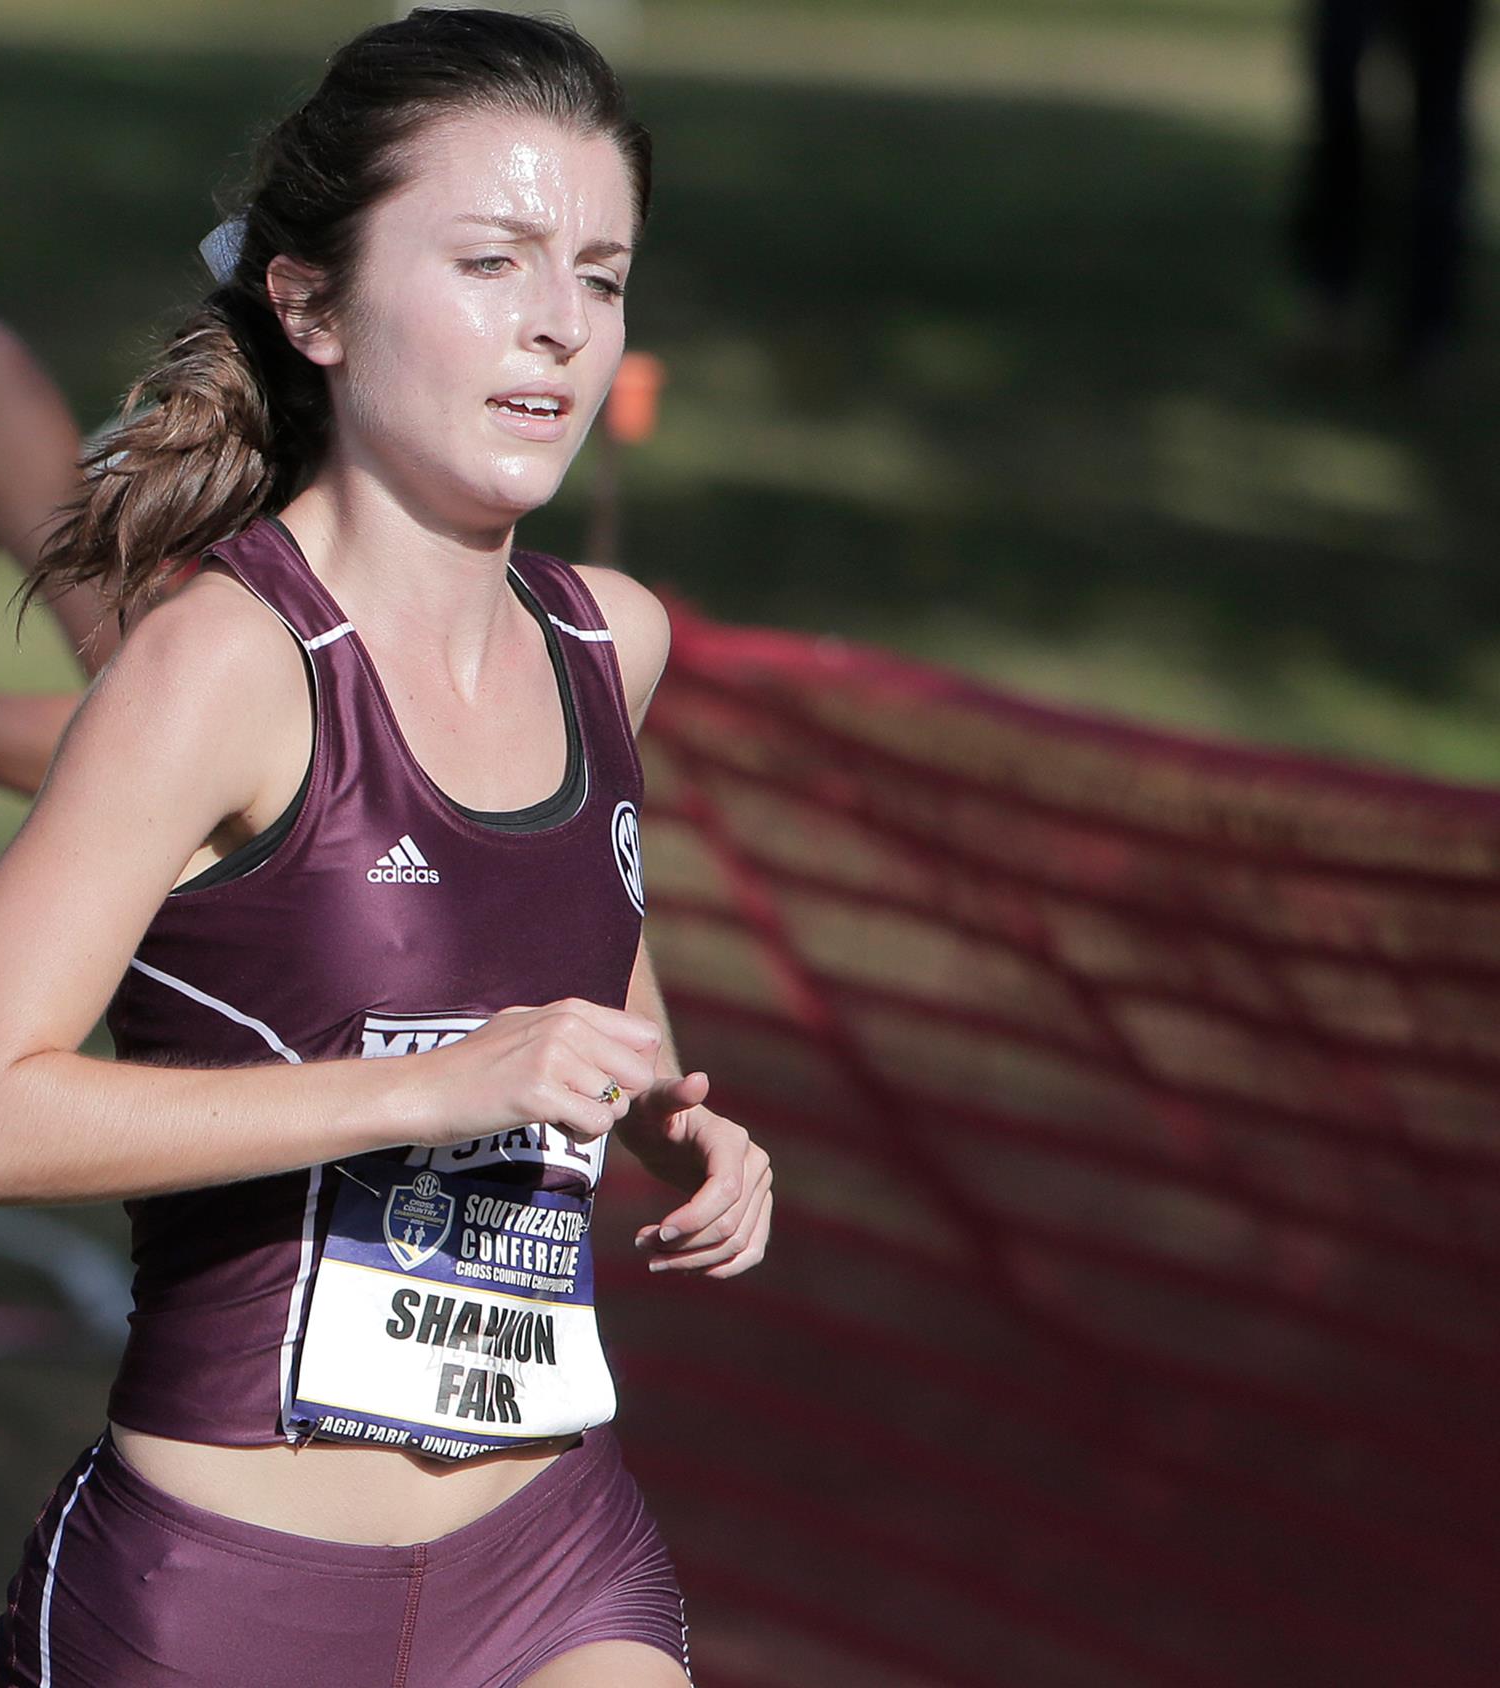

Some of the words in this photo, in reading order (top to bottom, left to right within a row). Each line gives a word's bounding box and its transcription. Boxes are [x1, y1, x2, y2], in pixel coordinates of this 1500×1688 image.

[366, 865, 441, 884] adidas
[416, 1174, 438, 1197] SEC
[403, 1204, 439, 1217] COUNTRY
[463, 1193, 583, 1242] SOUTHEASTER
[460, 1227, 580, 1276] CONFEREE
[455, 1260, 493, 1280] CROSS
[493, 1267, 533, 1288] COUNTRY
[320, 1415, 363, 1437] AGRI
[364, 1423, 411, 1446] PARK
